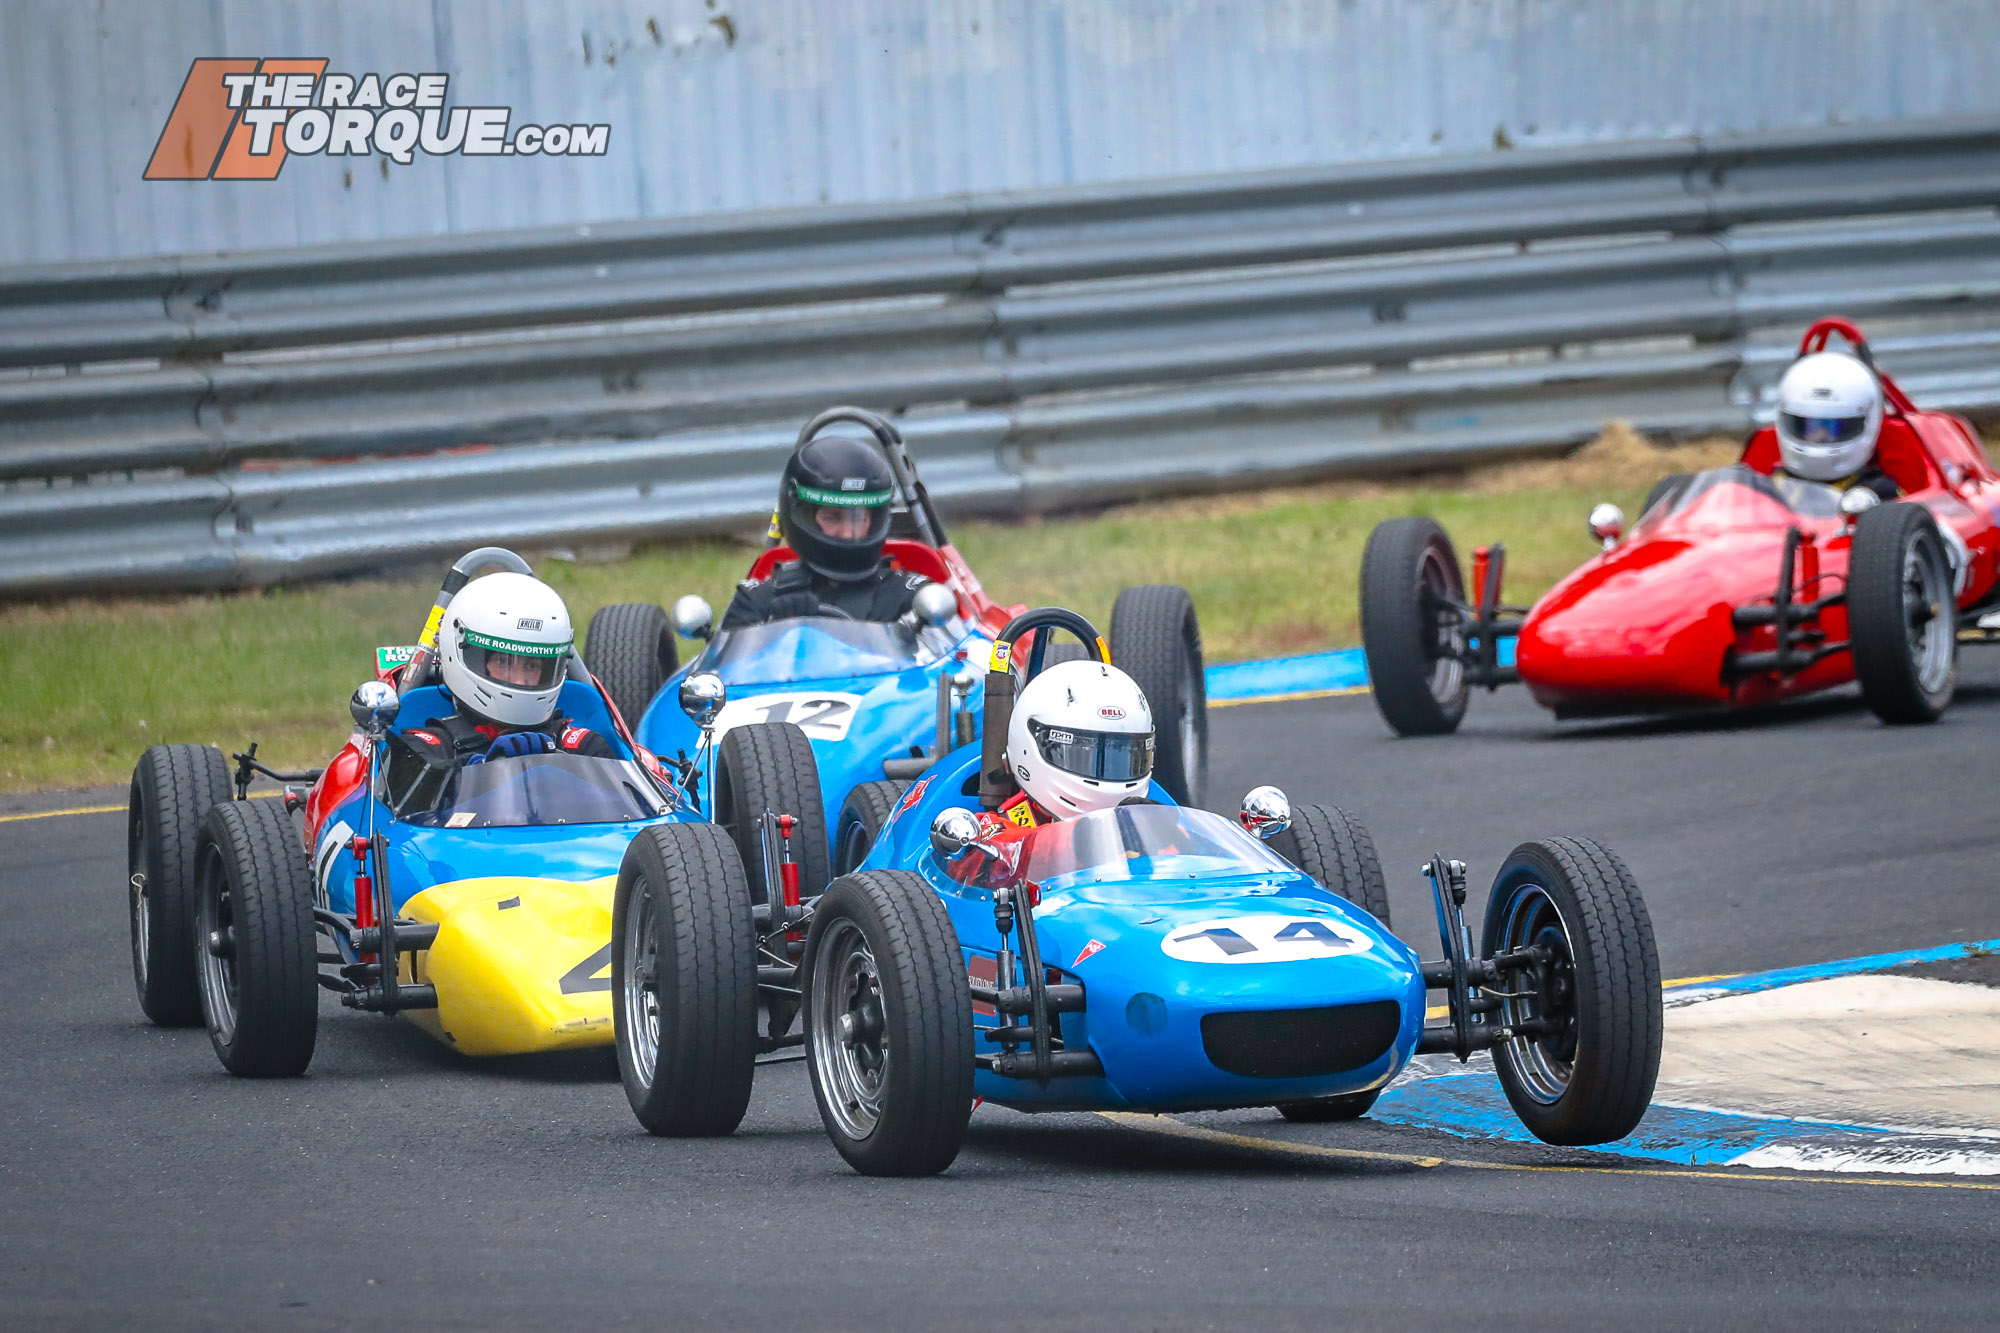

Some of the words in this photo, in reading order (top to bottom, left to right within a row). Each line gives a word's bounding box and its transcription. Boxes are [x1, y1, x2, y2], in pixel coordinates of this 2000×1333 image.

[474, 635, 491, 646] THE
[492, 640, 554, 655] ROADWORTHY
[755, 700, 852, 730] 12
[1172, 921, 1355, 957] 14
